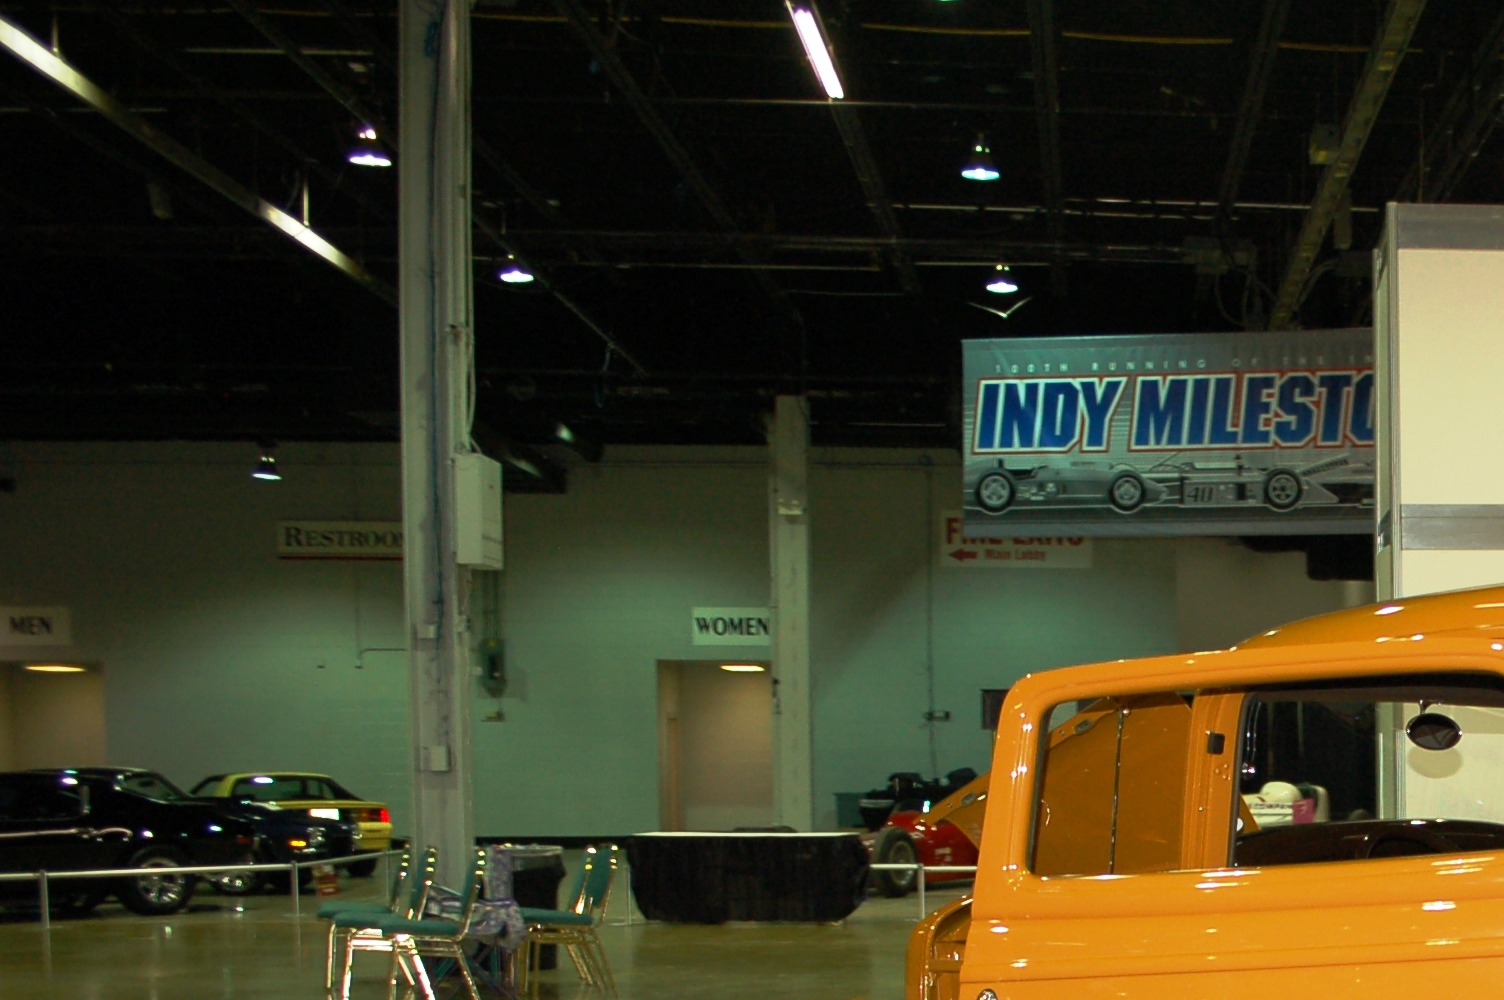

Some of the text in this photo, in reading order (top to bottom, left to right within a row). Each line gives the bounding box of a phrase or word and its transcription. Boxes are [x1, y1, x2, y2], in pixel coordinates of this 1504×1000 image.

[1091, 358, 1208, 373] RUNNING
[1231, 358, 1258, 368] OF
[972, 376, 1129, 454] INDY
[9, 616, 54, 635] MEN
[694, 616, 771, 636] WOMEN
